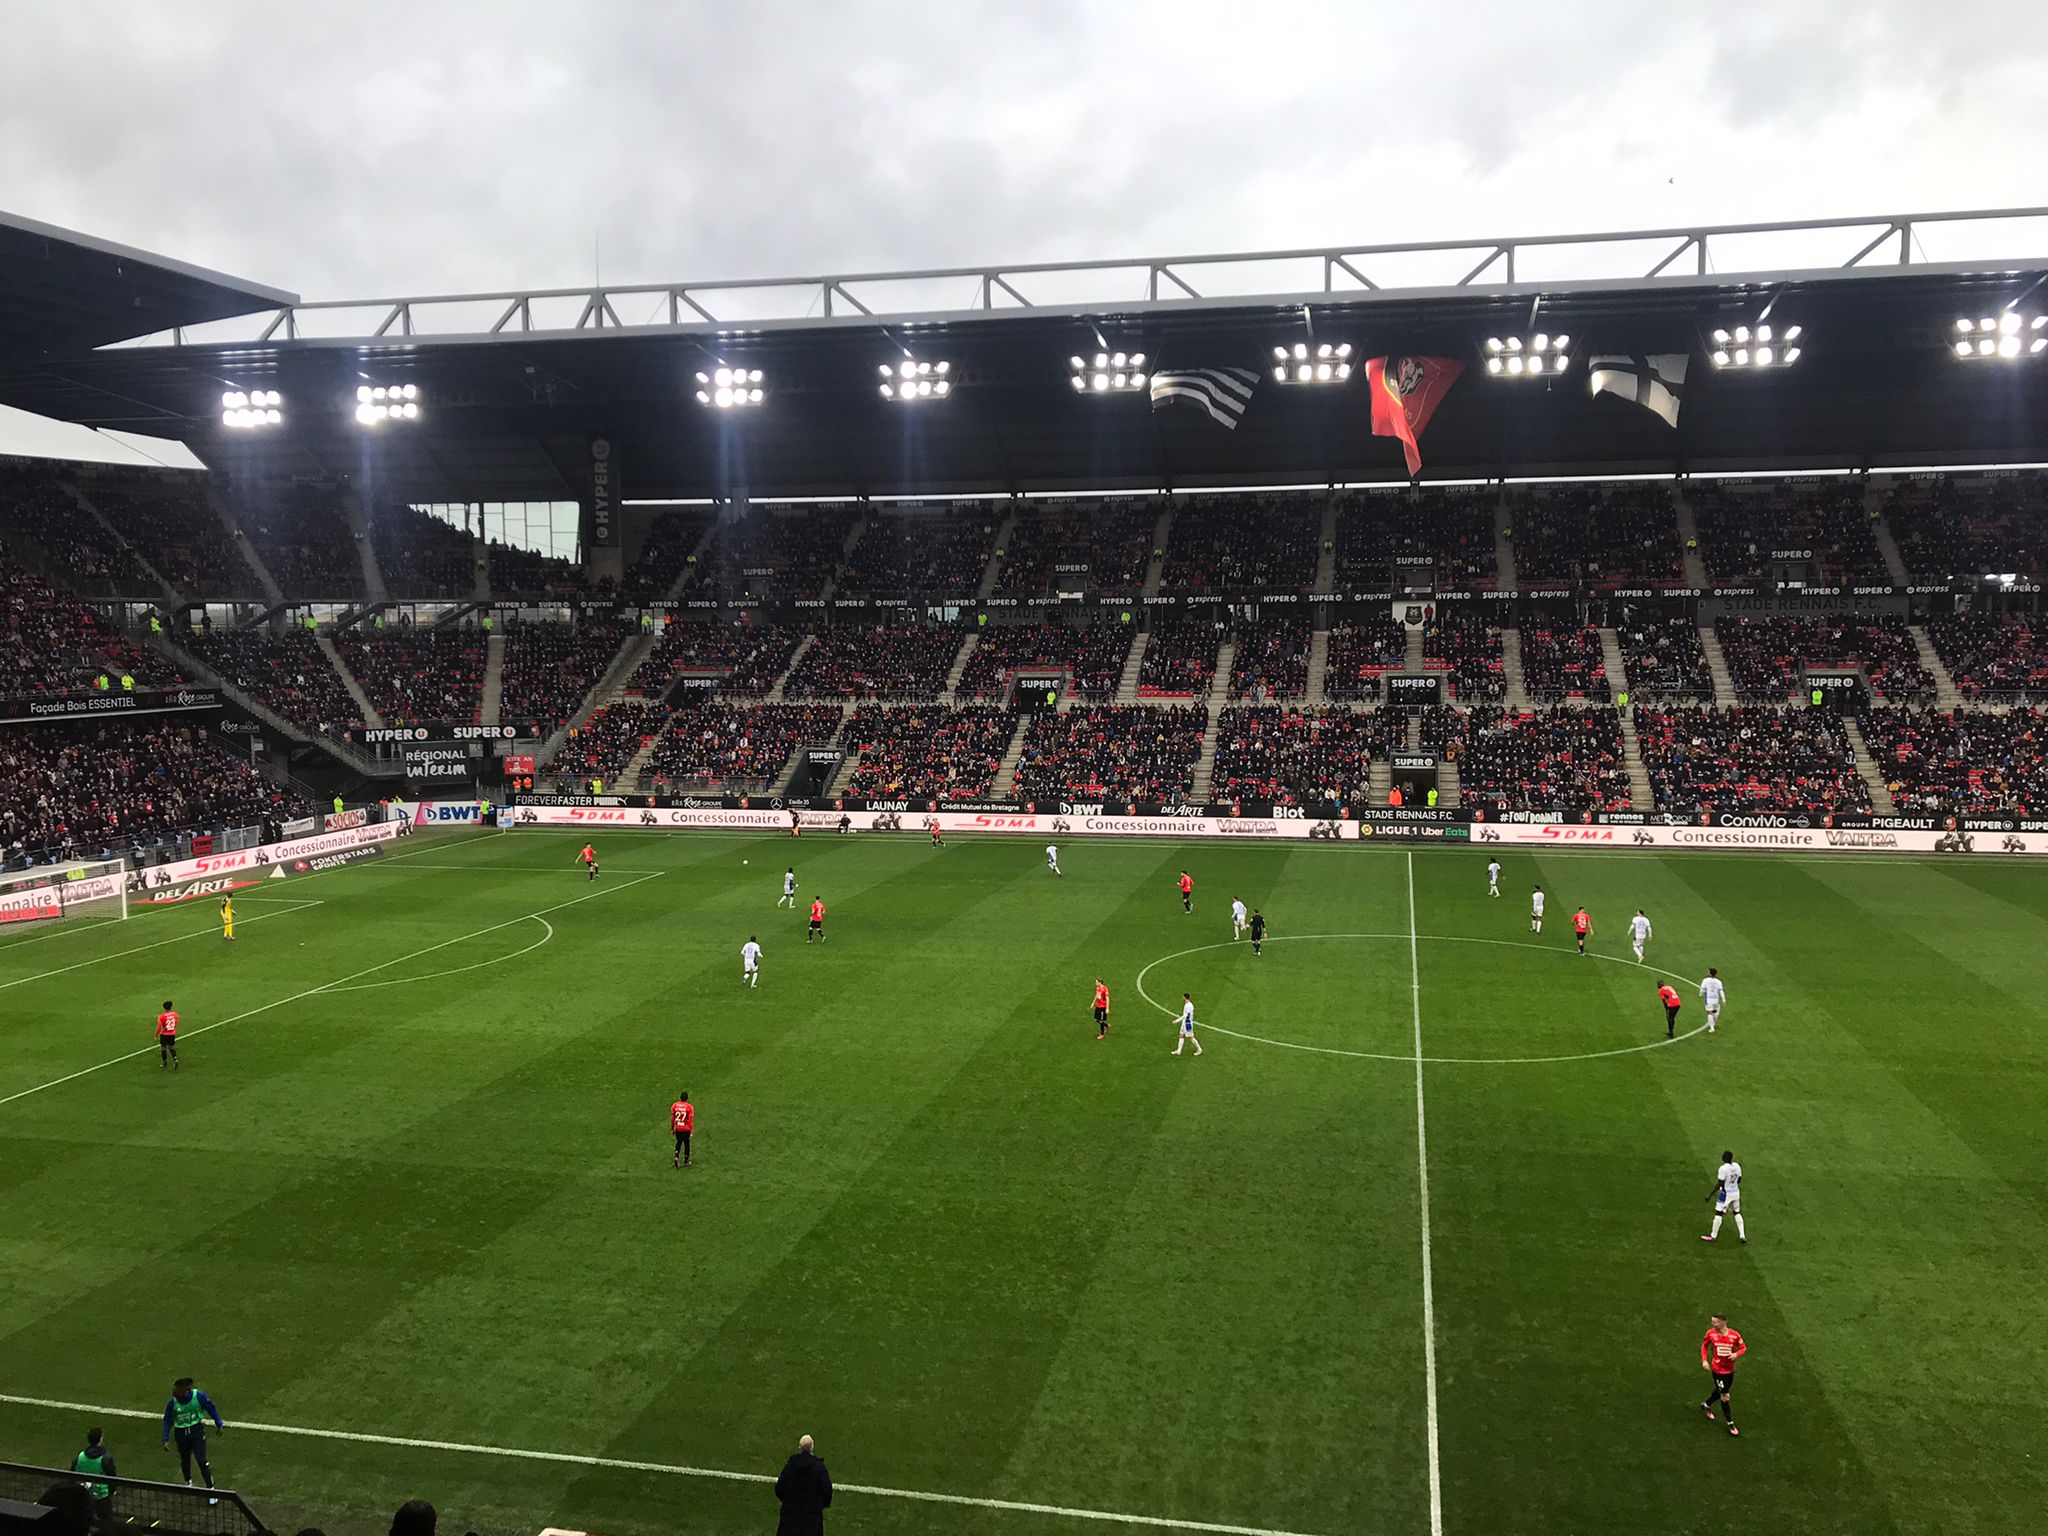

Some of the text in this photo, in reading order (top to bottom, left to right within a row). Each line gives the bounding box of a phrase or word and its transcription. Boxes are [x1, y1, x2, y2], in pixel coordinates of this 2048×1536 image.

[594, 461, 609, 523] HYPER
[1771, 550, 1802, 558] SUPER
[1396, 557, 1424, 565] SUPER
[1055, 564, 1080, 572] SUPER
[1614, 589, 1643, 597] HYPER
[1663, 589, 1692, 597] SUPER
[1723, 588, 1754, 596] express
[1801, 587, 1831, 595] HYPER
[1853, 587, 1883, 595] SUPER
[1916, 585, 1949, 594] express
[1263, 595, 1290, 603] HYPER
[1308, 594, 1334, 602] SUPER
[1362, 592, 1392, 601] express
[1435, 592, 1463, 600] HYPER
[1482, 591, 1510, 599] SUPER
[1539, 590, 1570, 599] express
[945, 599, 969, 607] HYPER
[986, 598, 1010, 606] SUPER
[1100, 597, 1125, 605] HYPER
[1143, 597, 1168, 605] SUPER
[1724, 599, 1772, 611] STADE
[1778, 598, 1849, 610] RENNAIS
[683, 679, 712, 688] SUPER
[1021, 680, 1051, 689] SUPER
[1391, 679, 1426, 688] SUPER
[30, 697, 136, 716] Façade Bois ESSENTIEL
[365, 728, 413, 742] HYPER
[453, 726, 502, 739] SUPER
[406, 749, 466, 761] RÉGIONAL
[809, 752, 834, 760] SUPER
[1394, 758, 1424, 766] SUPER
[684, 796, 702, 810] Rose
[866, 801, 909, 811] LAUNAY
[941, 802, 1020, 812] Crédit Mutuel de Bretagne
[439, 806, 481, 821] BWT
[1073, 804, 1104, 816] BWT
[1273, 806, 1305, 819] Blot
[333, 810, 360, 830] SOCIOS
[671, 811, 780, 824] Concessionnaire
[799, 811, 842, 826] ALTRA
[1365, 810, 1455, 821] STADE RENNAIS F.C.
[1085, 818, 1206, 832] Concessionnaire
[1216, 819, 1278, 834] VALTRA
[1872, 818, 1935, 829] PIGEAULT
[1964, 820, 2002, 830] HYPER
[1376, 826, 1468, 837] LIGUE 1 Uber Eats
[275, 832, 356, 859] Concessionnaire
[356, 825, 392, 842] VALTRA
[1673, 830, 1813, 845] Concessionnaire
[1825, 830, 1898, 848] VALTRA
[309, 846, 376, 867] POKERSTARS
[313, 859, 346, 871] SPORTS
[675, 1111, 687, 1121] 27
